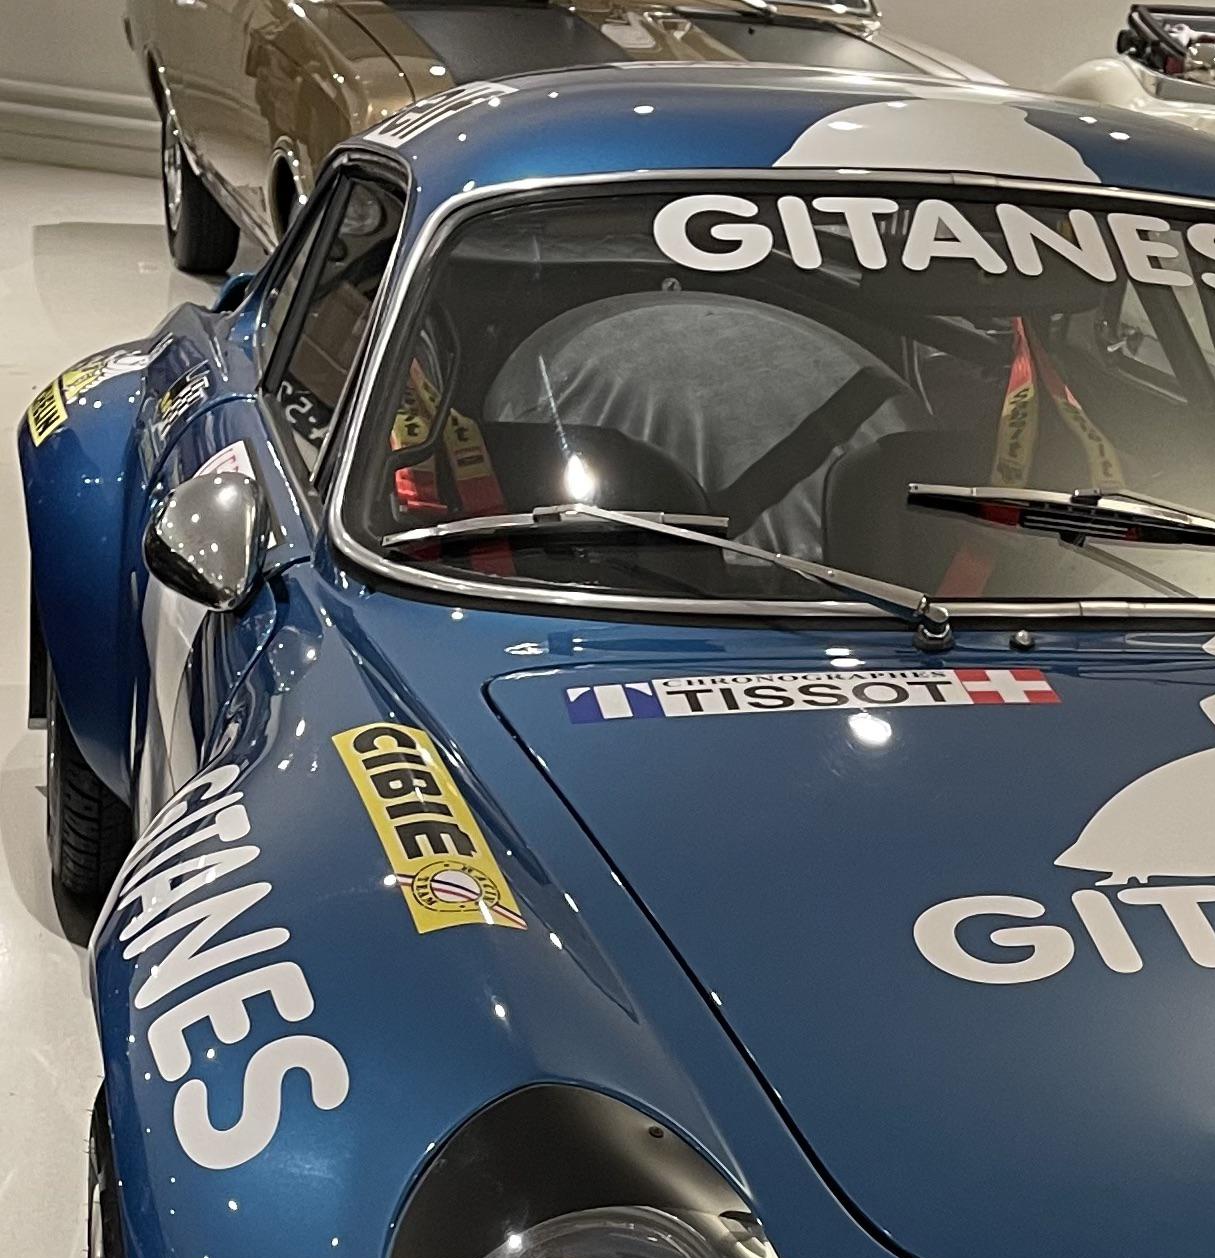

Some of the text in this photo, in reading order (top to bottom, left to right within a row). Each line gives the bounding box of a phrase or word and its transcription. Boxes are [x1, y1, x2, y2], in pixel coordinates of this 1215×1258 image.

[662, 671, 947, 688] CHRONOGRAPHES
[666, 680, 953, 713] TISSOT
[116, 765, 350, 1170] GITANES
